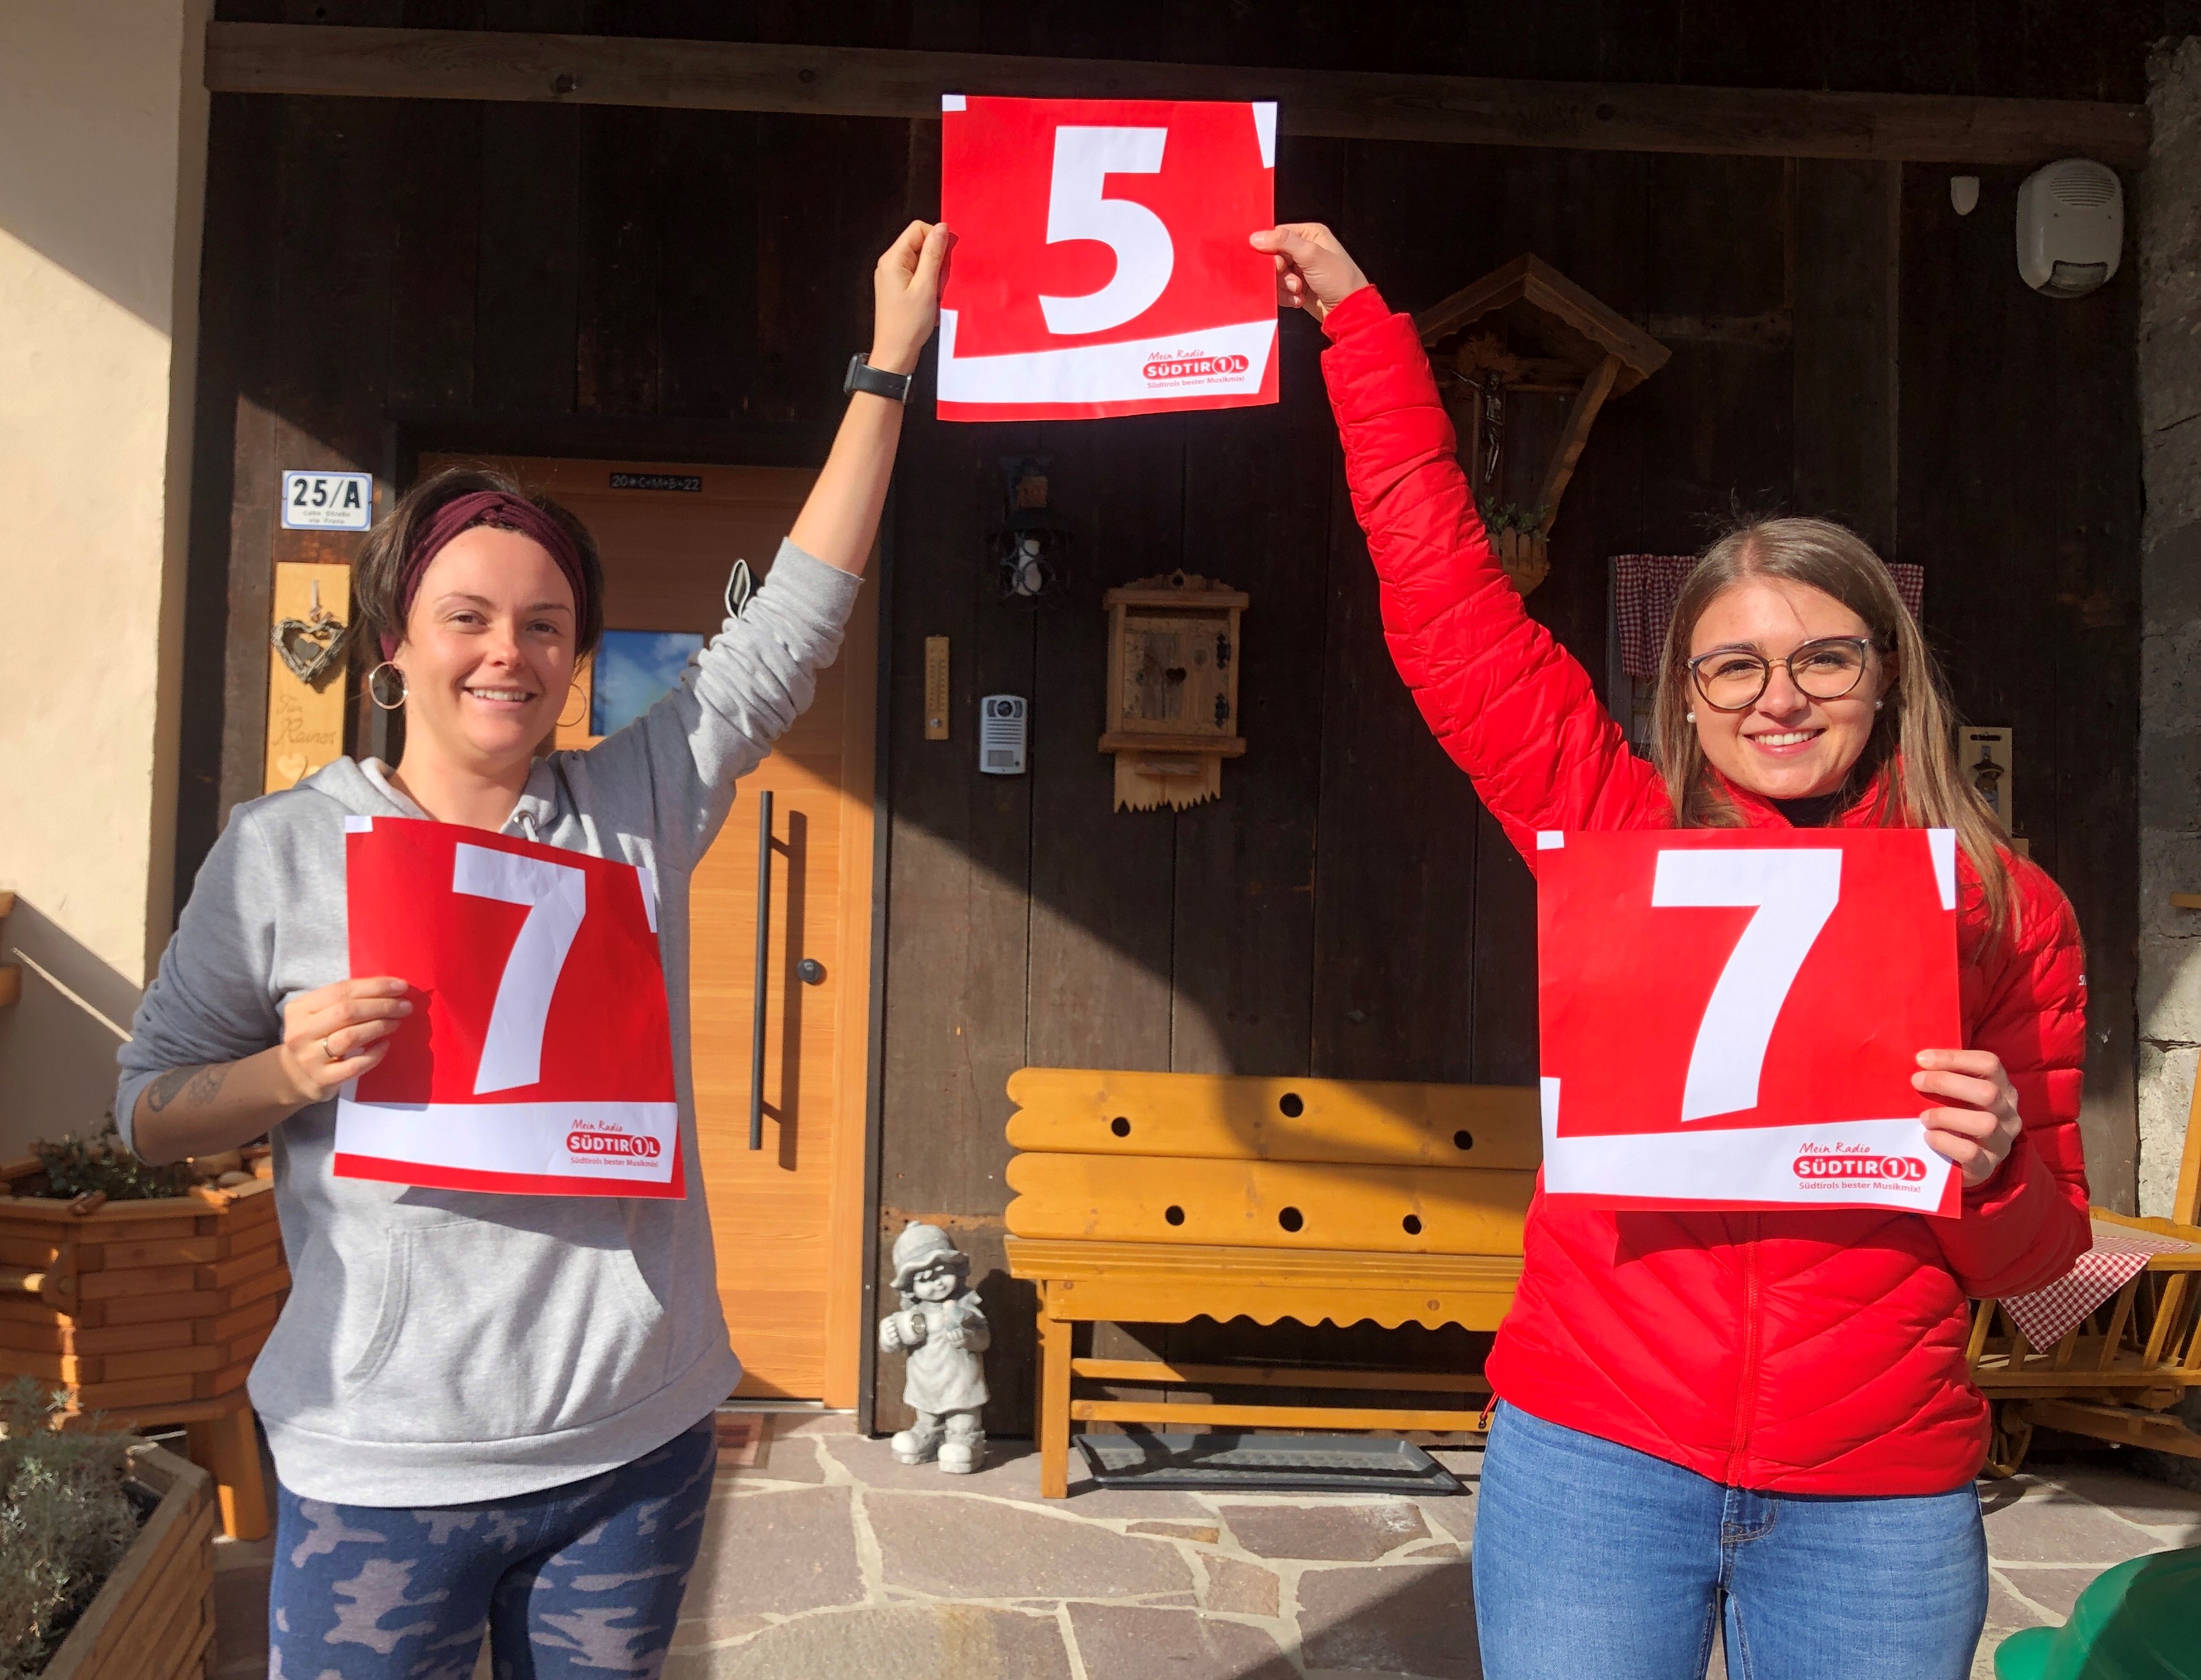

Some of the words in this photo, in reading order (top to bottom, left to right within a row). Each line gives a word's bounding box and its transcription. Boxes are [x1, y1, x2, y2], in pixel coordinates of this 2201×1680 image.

[1039, 125, 1174, 335] 5
[1147, 352, 1173, 361] Mein
[1176, 349, 1205, 359] Radio
[1147, 380, 1180, 389] Südtirols
[1182, 377, 1205, 386] bester
[294, 479, 360, 508] 25/A
[452, 842, 586, 1095] 7
[1651, 848, 1843, 1123] 7
[572, 1119, 595, 1130] Mein
[598, 1120, 623, 1132] Radio
[1798, 1142, 1831, 1154] Mein
[1835, 1142, 1871, 1153] Radio
[1798, 1181, 1839, 1189] Südtirols
[1841, 1181, 1871, 1189] bester
[1873, 1182, 1921, 1193] Musikmix!
